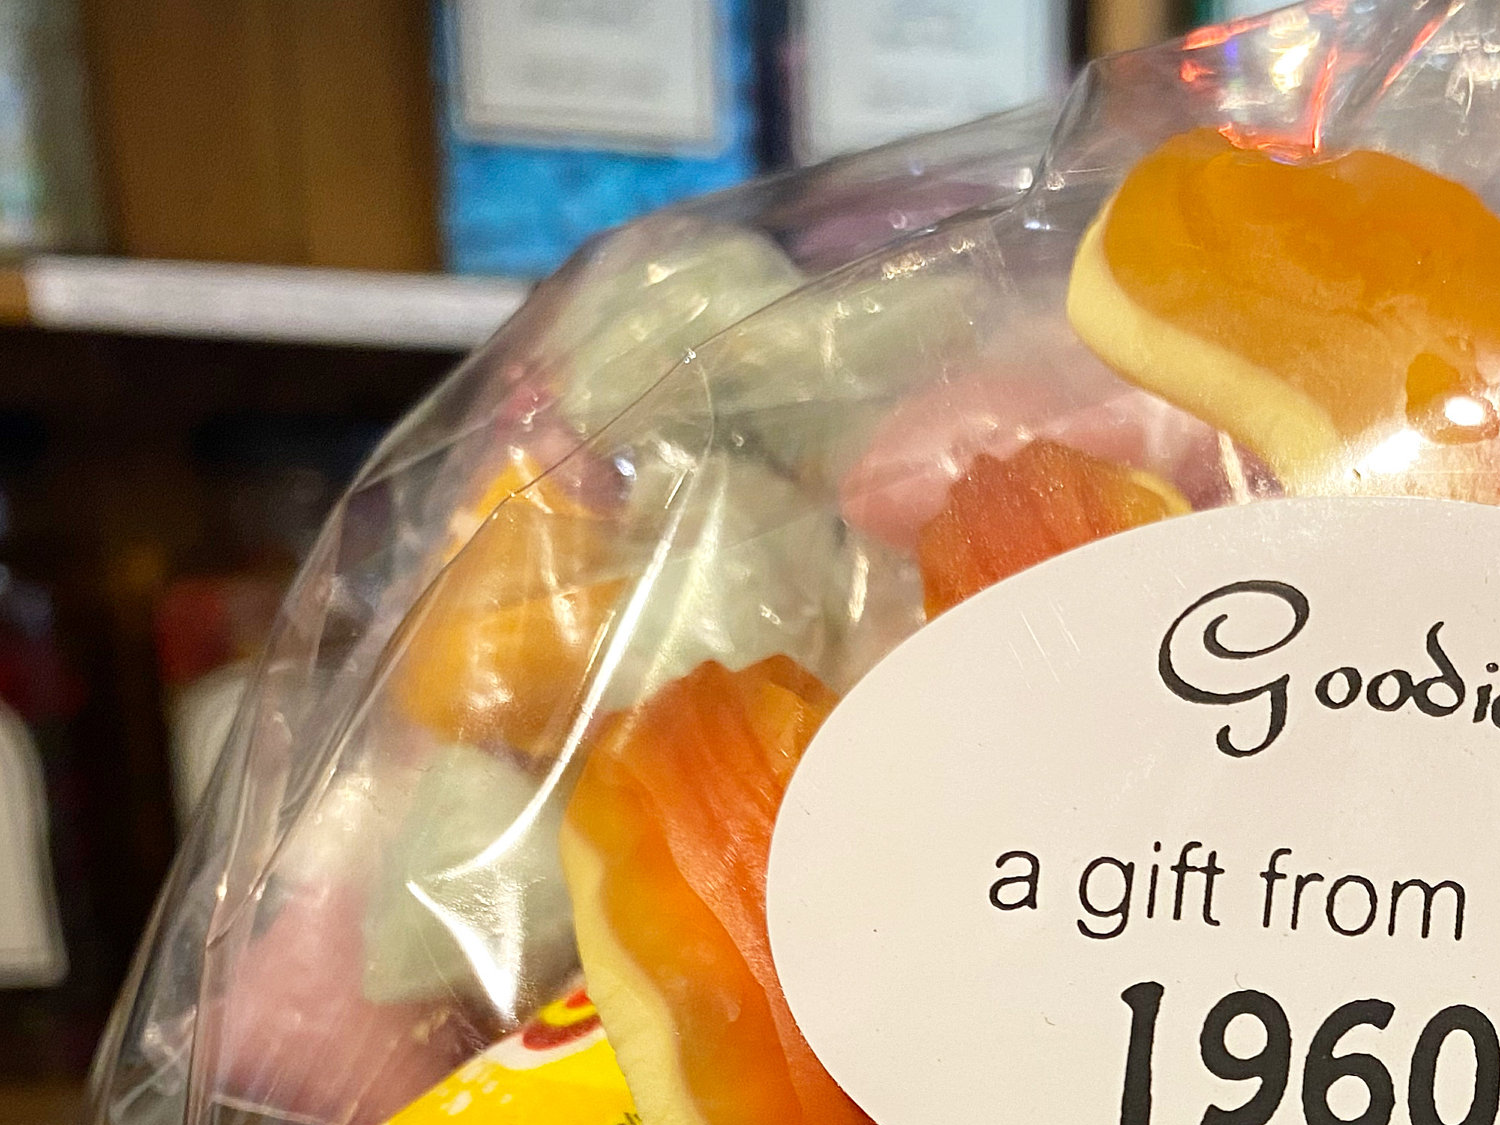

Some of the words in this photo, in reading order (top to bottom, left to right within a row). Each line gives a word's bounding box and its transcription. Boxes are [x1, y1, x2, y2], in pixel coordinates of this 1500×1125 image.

[988, 848, 1040, 912] a
[1076, 840, 1225, 939] gift
[1260, 847, 1466, 941] from
